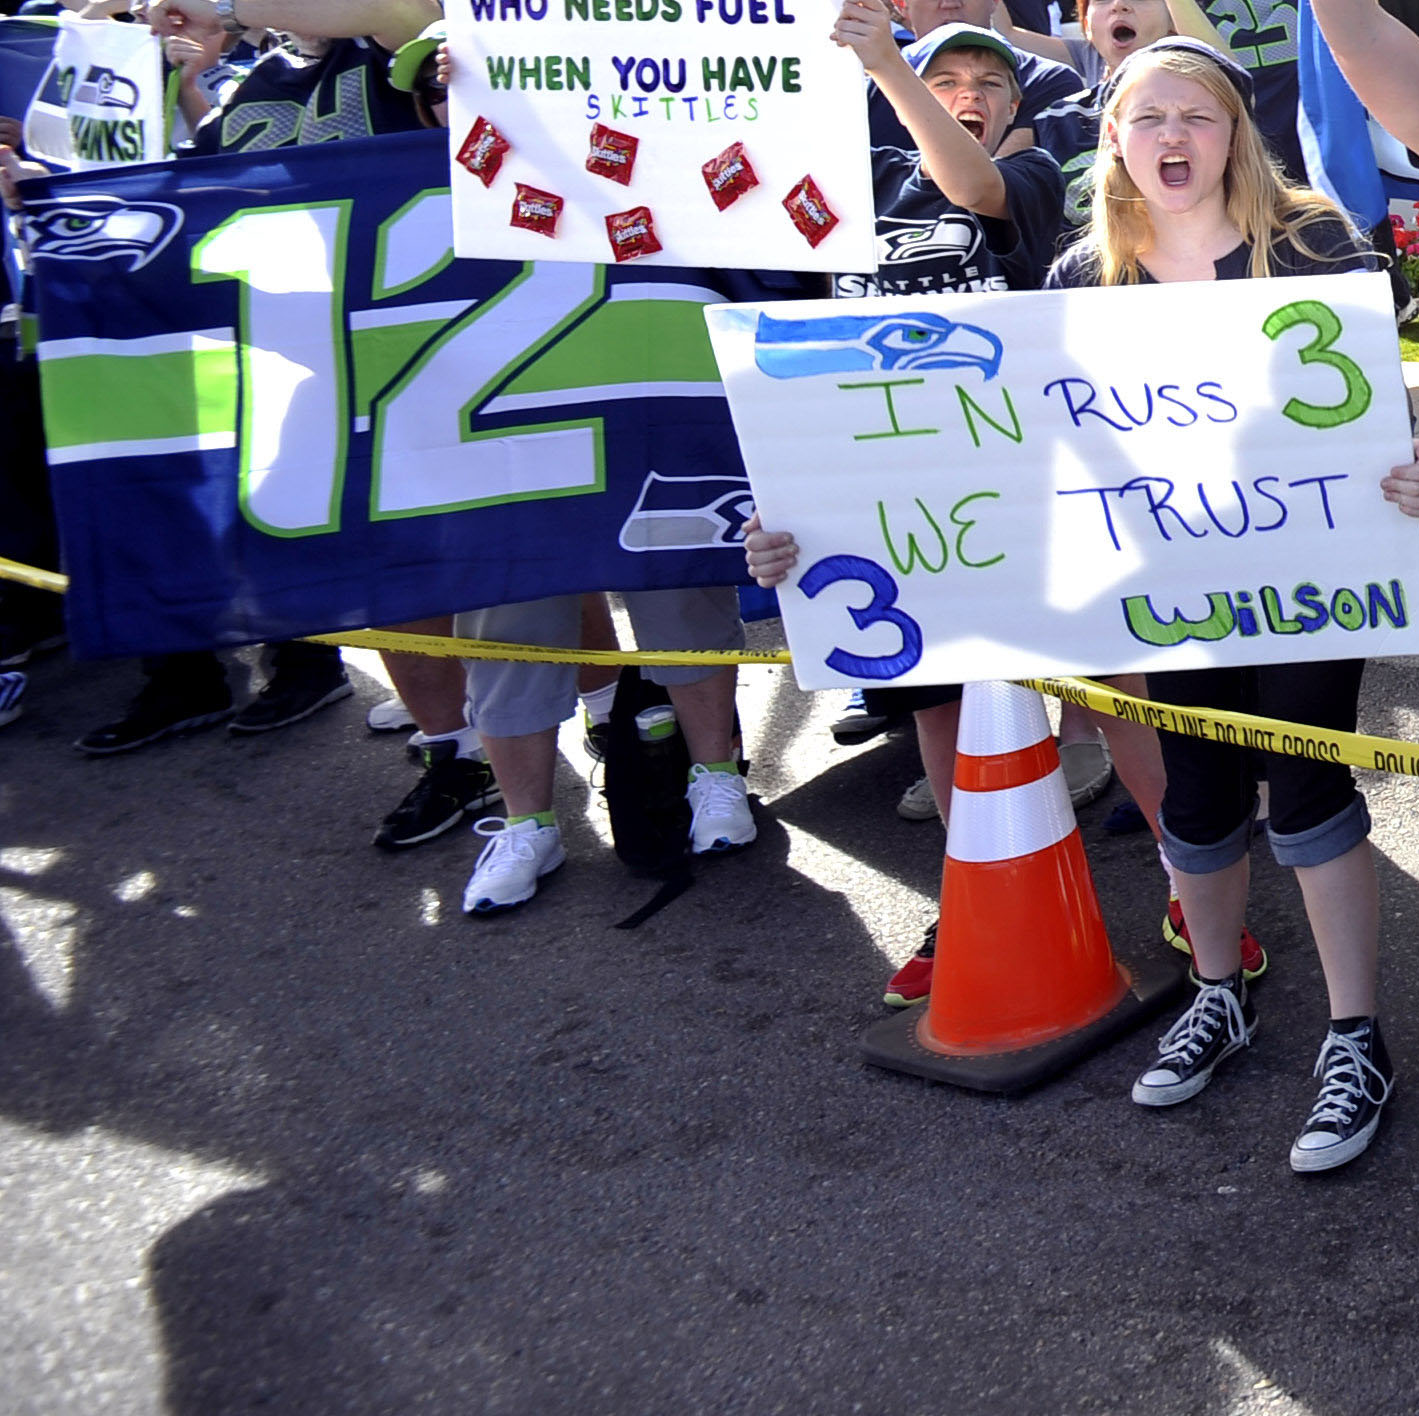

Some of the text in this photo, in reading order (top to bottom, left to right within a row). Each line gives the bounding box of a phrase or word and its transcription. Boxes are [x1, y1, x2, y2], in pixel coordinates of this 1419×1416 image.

[221, 64, 375, 154] 24
[486, 55, 802, 94] WHEN YOU HAVE
[586, 94, 760, 123] SKITTLES
[191, 187, 606, 539] 12
[837, 300, 1373, 448] IN RUSS 3
[877, 473, 1350, 576] WE TRUST
[798, 554, 923, 681] 3
